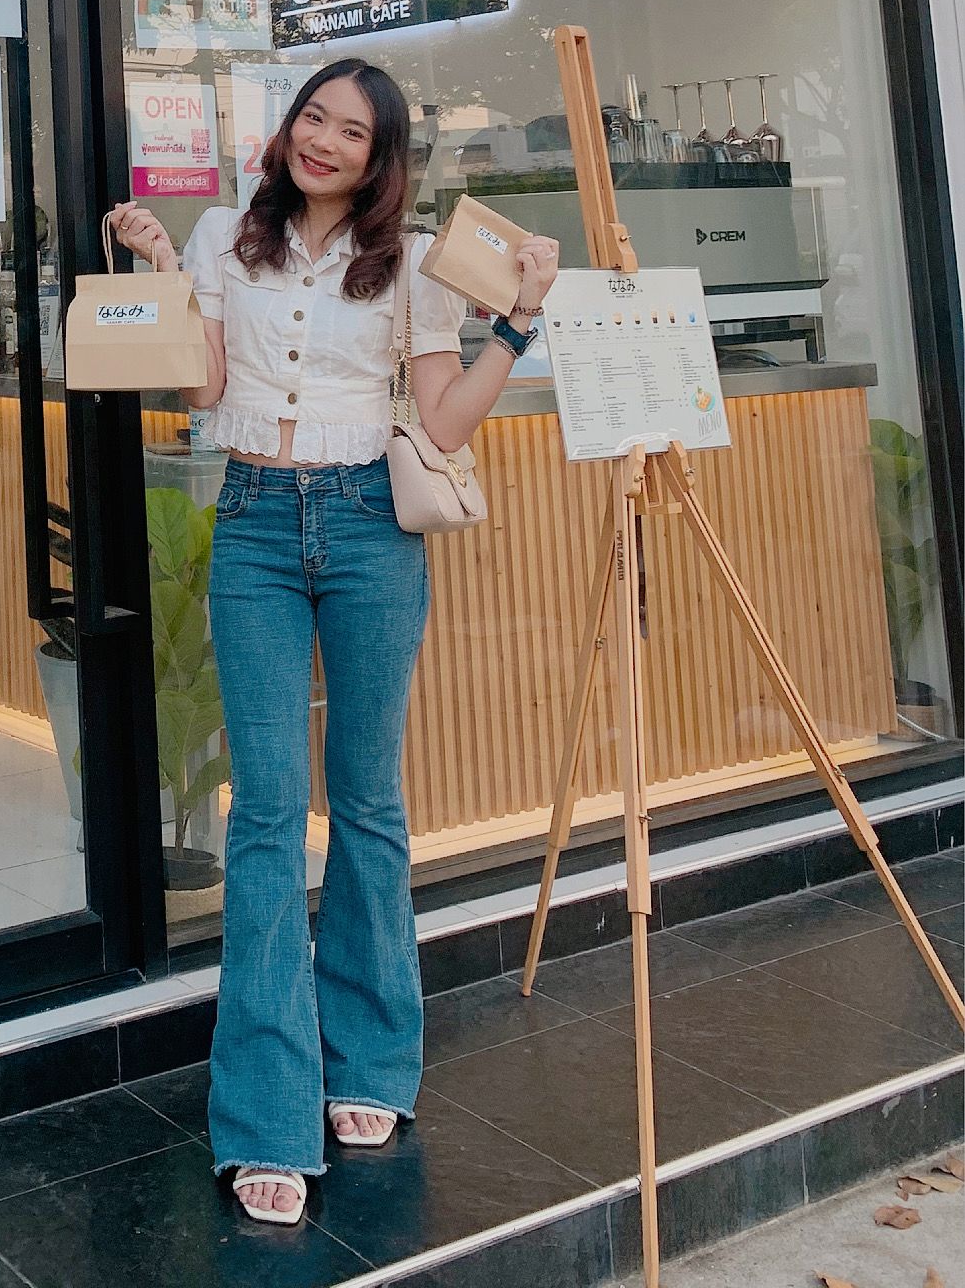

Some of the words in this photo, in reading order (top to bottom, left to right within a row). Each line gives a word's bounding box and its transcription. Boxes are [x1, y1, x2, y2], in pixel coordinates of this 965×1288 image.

[309, 8, 364, 34] NANAMI
[369, 0, 411, 24] CAFE
[264, 77, 293, 91] ななみ
[145, 95, 203, 120] OPEN
[159, 175, 207, 188] foodpanda
[710, 230, 746, 242] CREM
[608, 278, 635, 292] ななみ
[98, 304, 145, 319] ななみ
